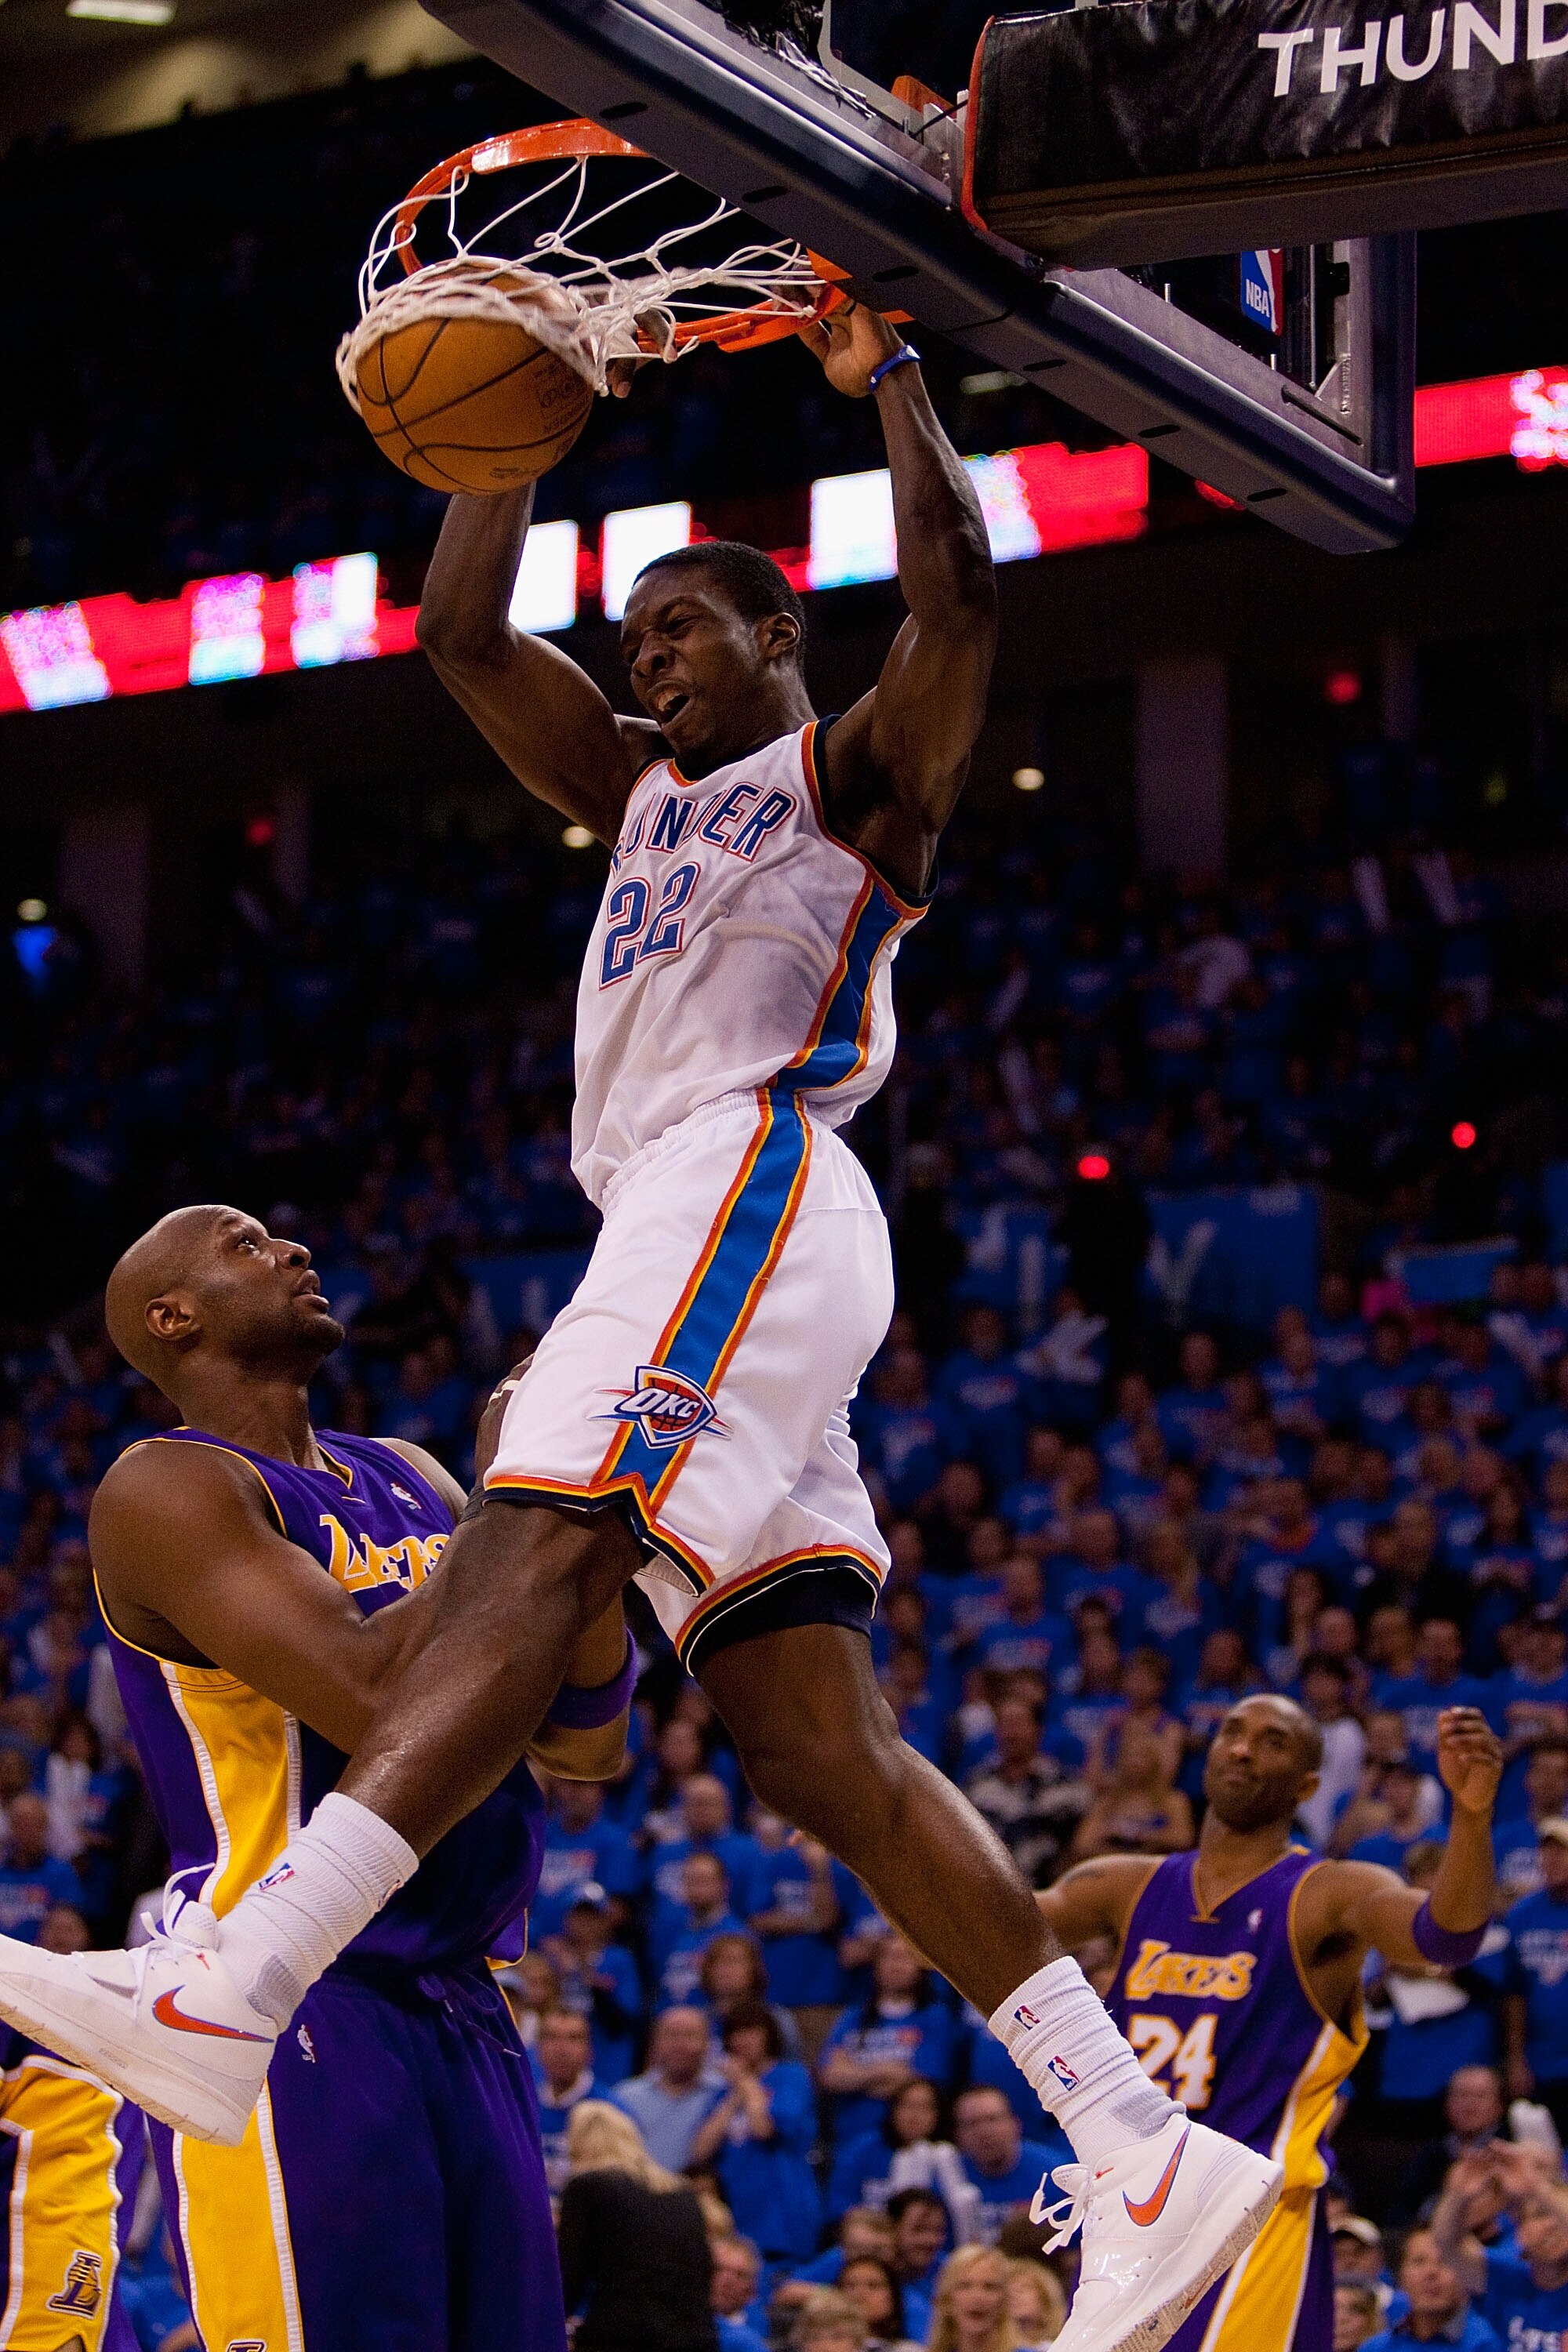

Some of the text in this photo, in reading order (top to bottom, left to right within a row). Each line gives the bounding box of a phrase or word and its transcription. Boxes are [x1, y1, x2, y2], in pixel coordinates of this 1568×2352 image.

[1245, 278, 1270, 318] NBA
[599, 862, 701, 991] 22
[618, 1386, 702, 1419] OKC
[1127, 2013, 1218, 2111] 24
